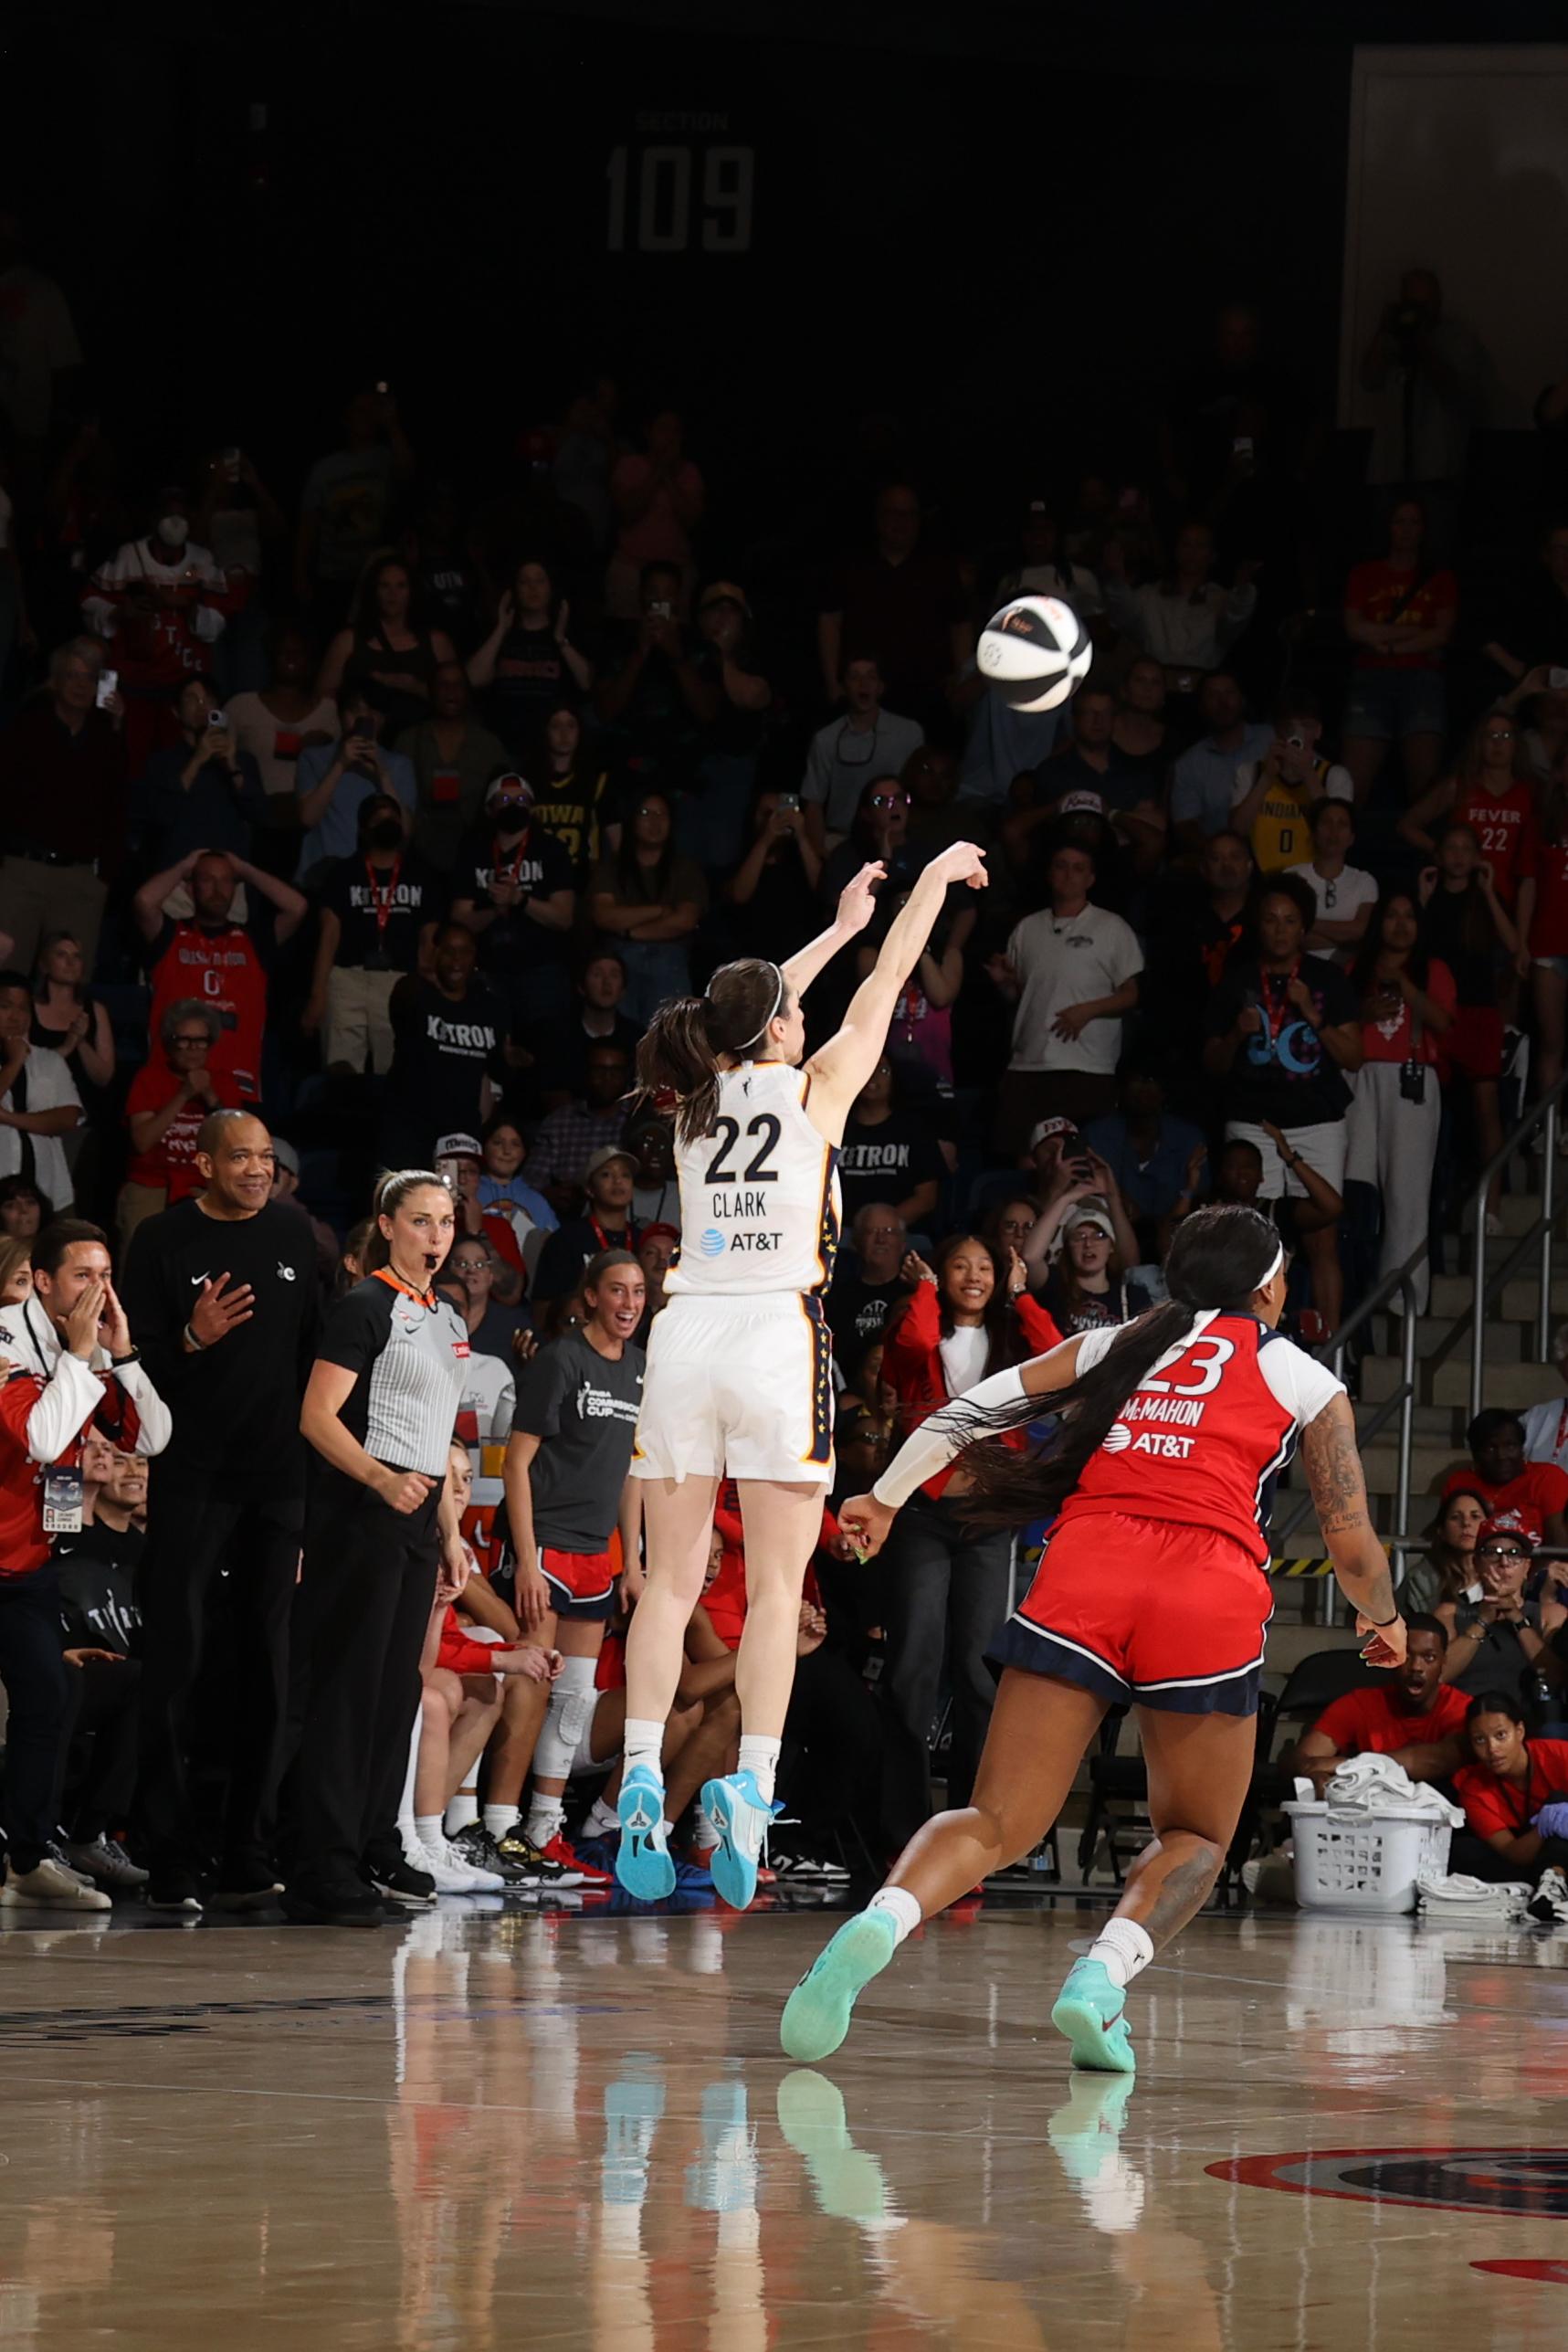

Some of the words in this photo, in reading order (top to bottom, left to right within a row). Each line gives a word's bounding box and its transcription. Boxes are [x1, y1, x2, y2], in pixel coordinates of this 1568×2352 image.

[636, 111, 731, 132] SECTION
[606, 146, 755, 252] 109
[1468, 807, 1521, 824] FEVER
[1280, 829, 1292, 852] 0
[1481, 827, 1509, 852] 22
[705, 1113, 781, 1184] 22
[712, 1192, 766, 1218] CLARK
[731, 1233, 783, 1251] AT&T
[1136, 1335, 1235, 1396] 23
[586, 1406, 615, 1418] CUP
[1117, 1397, 1205, 1428] McMAHON
[1131, 1432, 1195, 1459] AT&T
